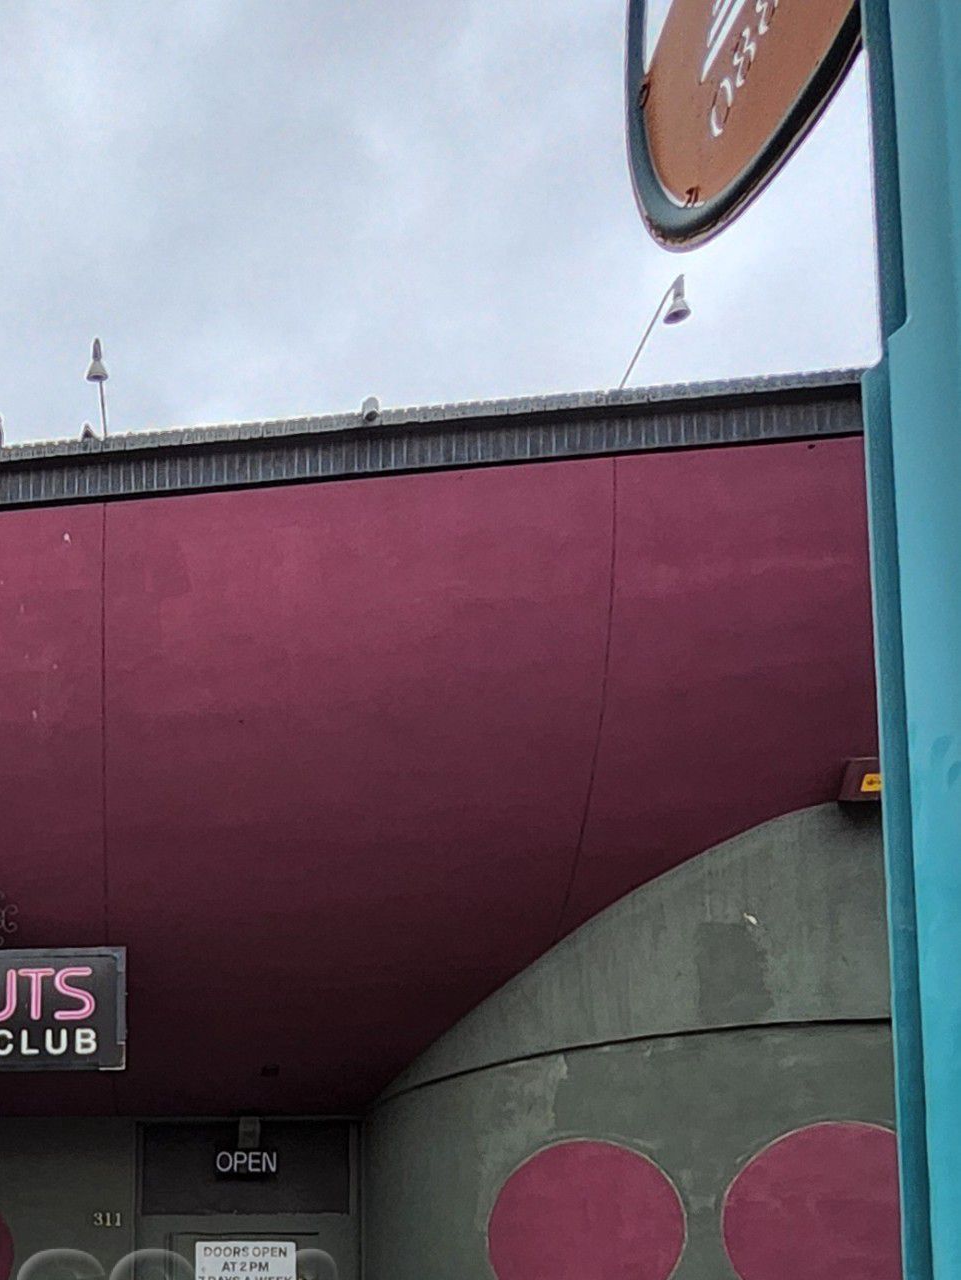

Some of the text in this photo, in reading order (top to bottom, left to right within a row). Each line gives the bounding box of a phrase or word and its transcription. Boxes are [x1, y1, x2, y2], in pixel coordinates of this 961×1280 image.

[216, 1151, 277, 1173] OPEN
[93, 1212, 122, 1227] 311
[203, 1247, 287, 1257] DOORS OPEN
[221, 1261, 269, 1272] AT 2 PM
